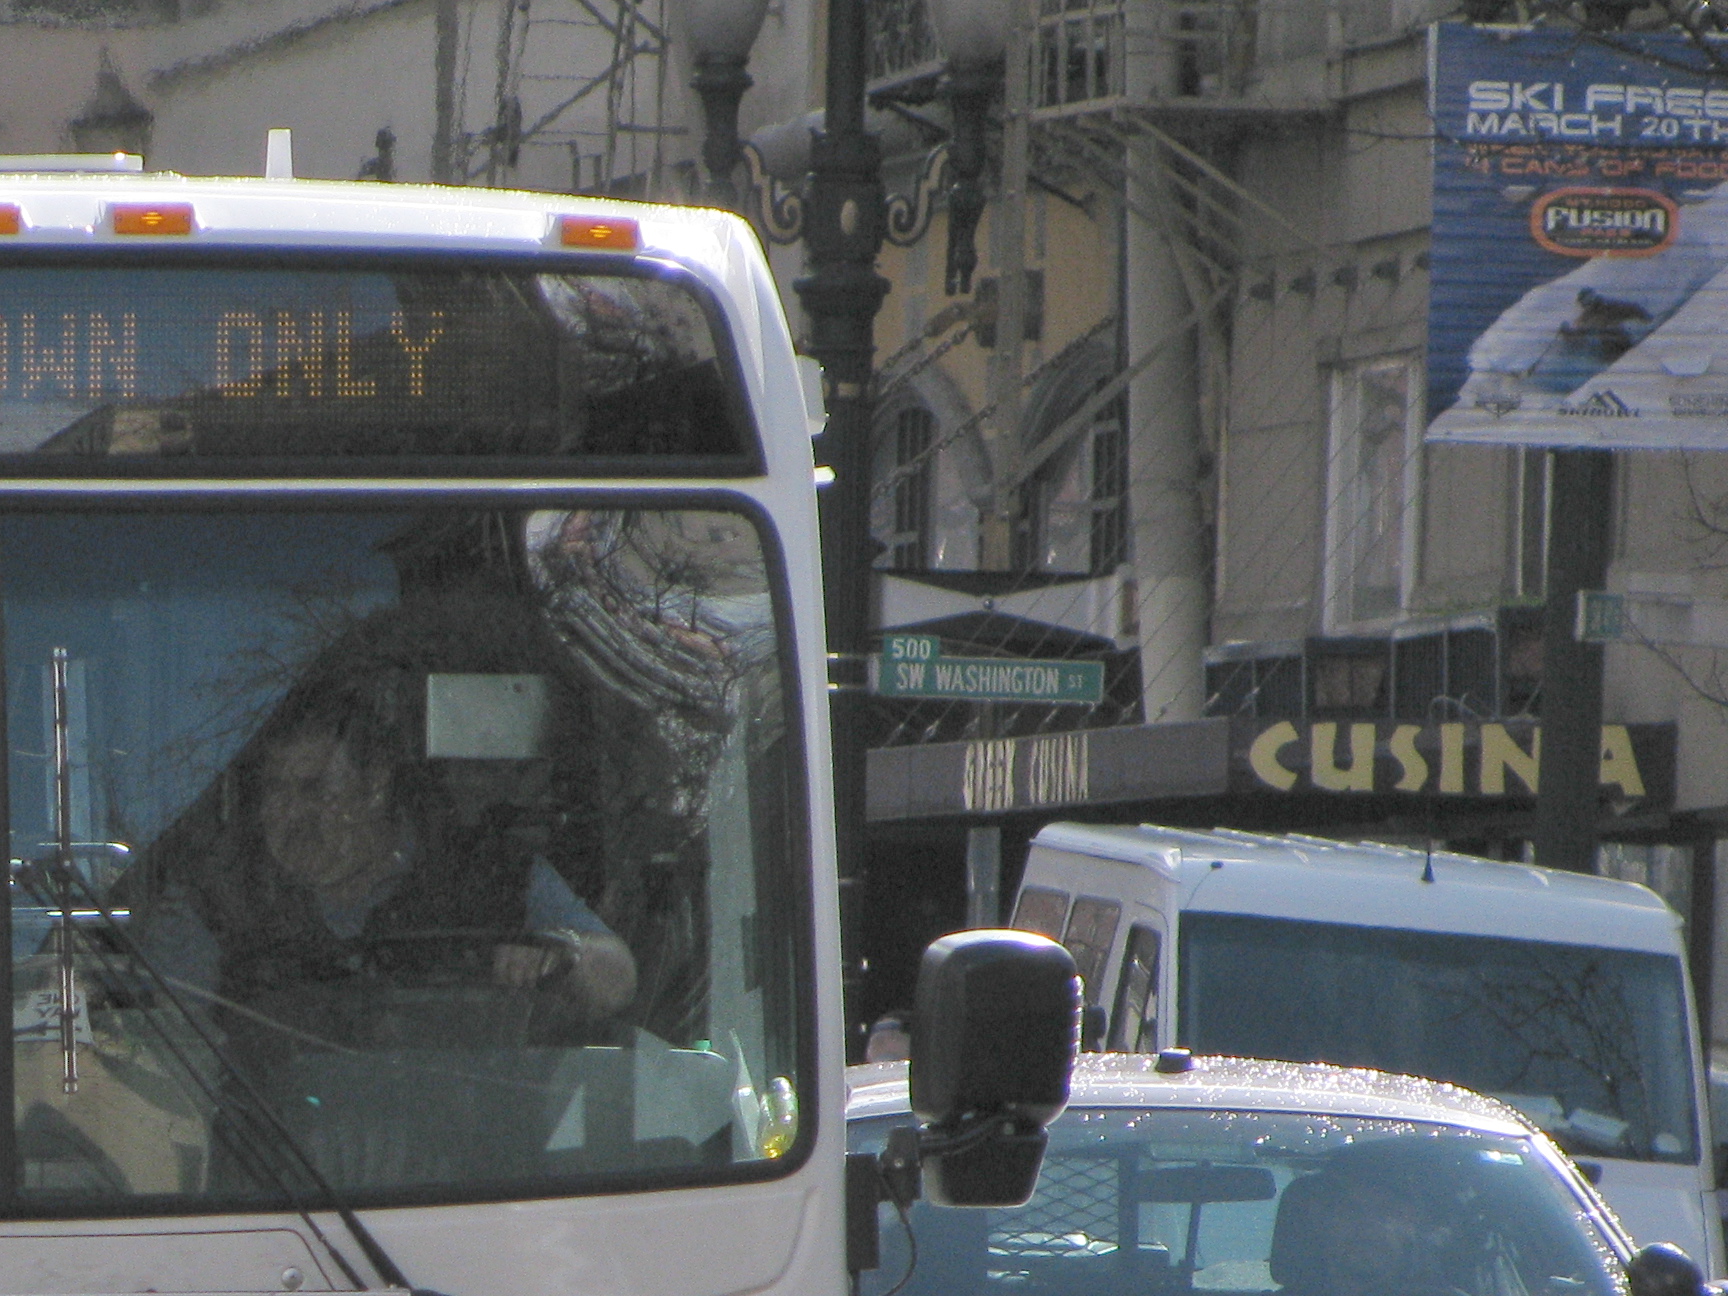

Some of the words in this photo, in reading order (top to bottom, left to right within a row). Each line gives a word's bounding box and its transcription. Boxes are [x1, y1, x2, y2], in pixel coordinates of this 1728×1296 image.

[1469, 81, 1564, 112] SKI
[1466, 112, 1622, 137] MARCH
[1601, 159, 1644, 177] OF
[217, 310, 444, 397] ONLY
[891, 637, 932, 660] 500
[896, 662, 925, 690] SW
[935, 664, 1060, 694] WASHINGTON
[1068, 673, 1084, 689] ST
[1249, 720, 1646, 797] CUSINA
